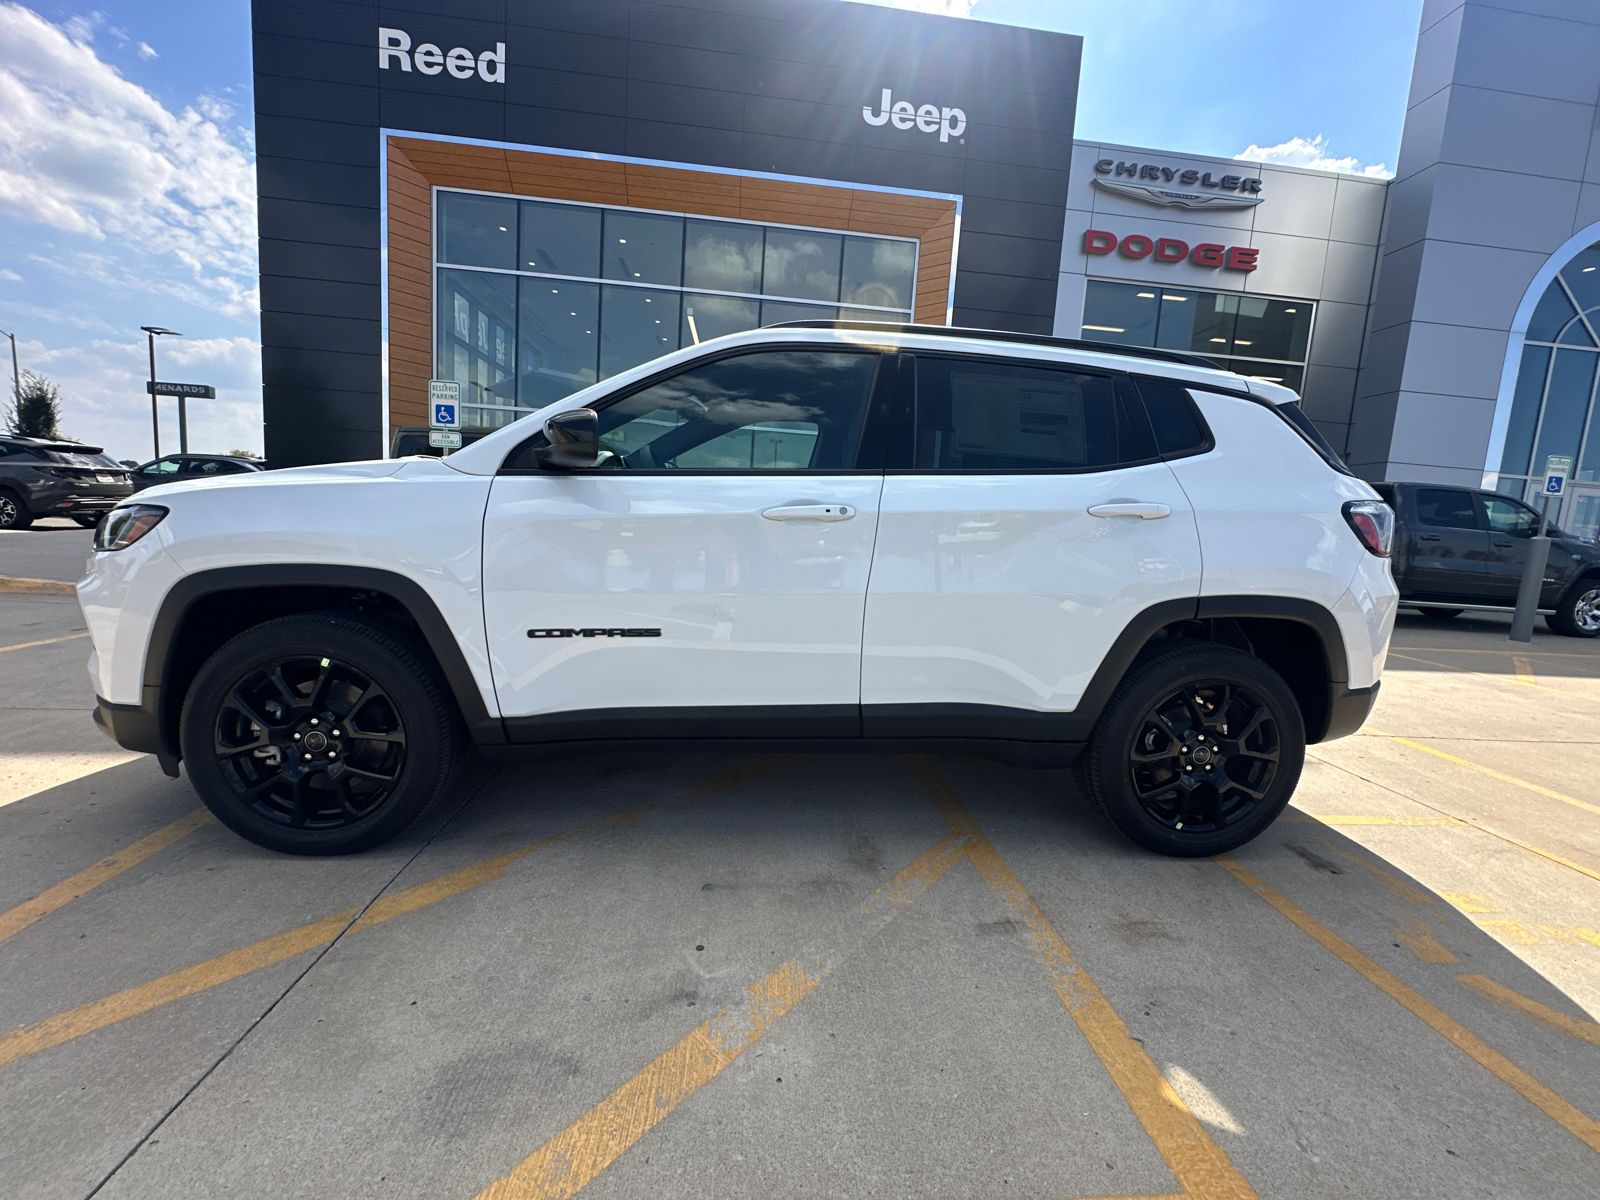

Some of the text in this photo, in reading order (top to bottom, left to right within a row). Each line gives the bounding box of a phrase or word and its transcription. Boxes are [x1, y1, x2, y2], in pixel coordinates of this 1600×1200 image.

[378, 26, 506, 84] Reed
[862, 87, 967, 143] Jeep
[1095, 158, 1263, 193] CHRYSLER
[1083, 229, 1260, 272] DODGE
[432, 384, 458, 393] RESERVED
[432, 392, 458, 401] PARKING
[527, 628, 662, 638] COMPASS
